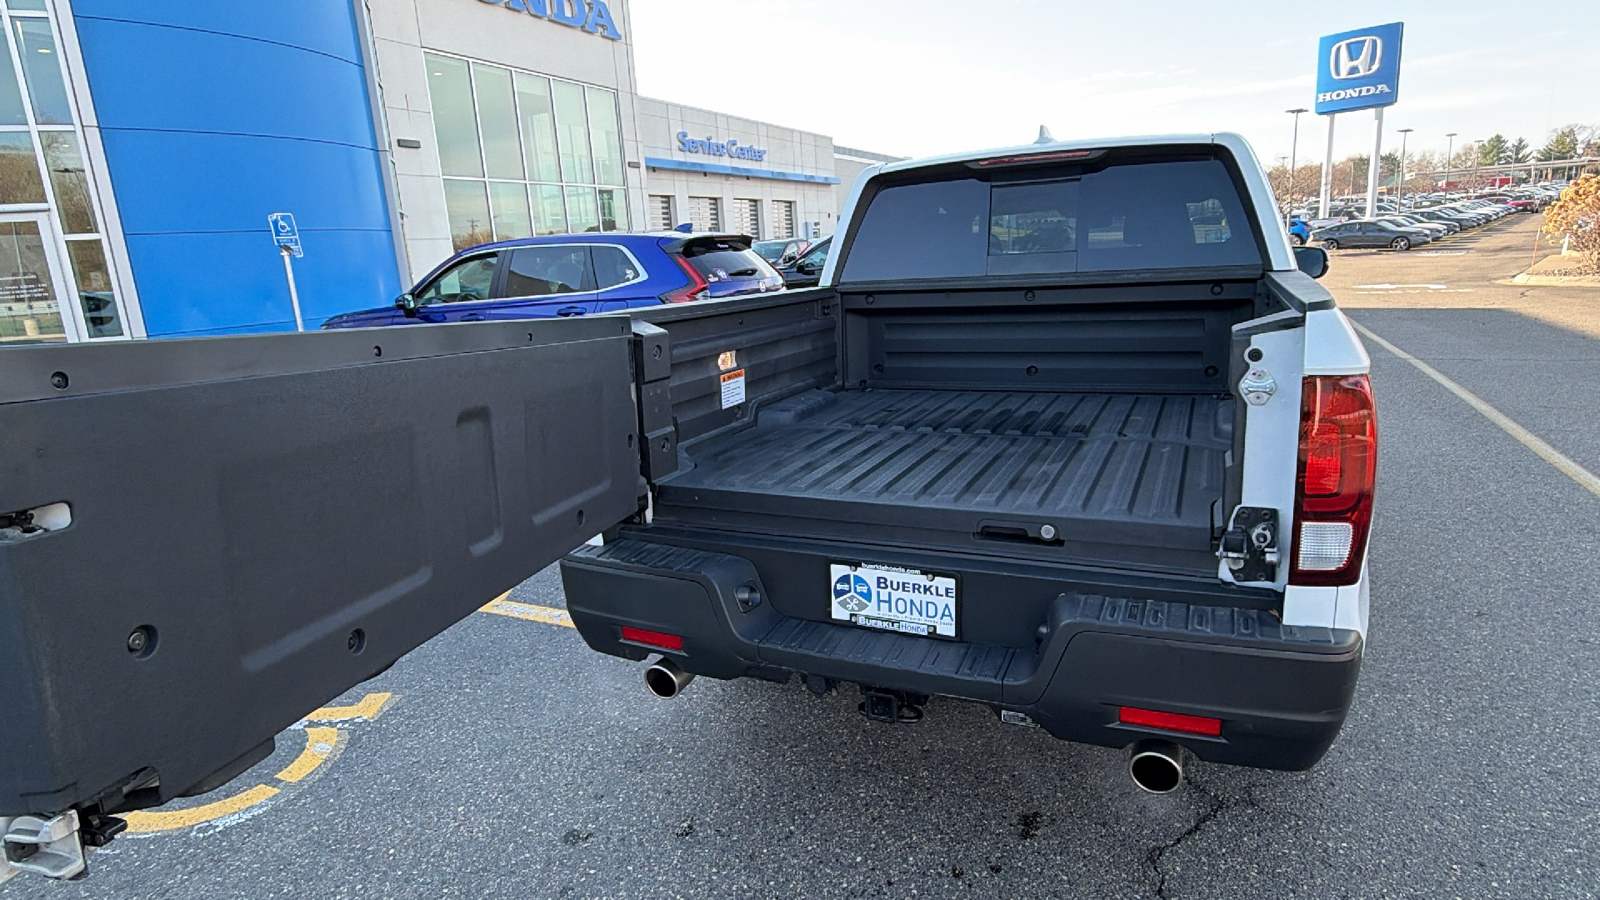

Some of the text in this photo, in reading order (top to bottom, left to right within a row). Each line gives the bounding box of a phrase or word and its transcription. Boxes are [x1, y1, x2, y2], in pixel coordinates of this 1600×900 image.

[1317, 84, 1392, 103] HONDA
[677, 131, 766, 162] Service Center
[861, 562, 921, 575] buerklehonda.com
[876, 576, 955, 599] BUERKLE
[876, 590, 954, 622] HONDA
[858, 616, 926, 634] BUERKLE HONDA
